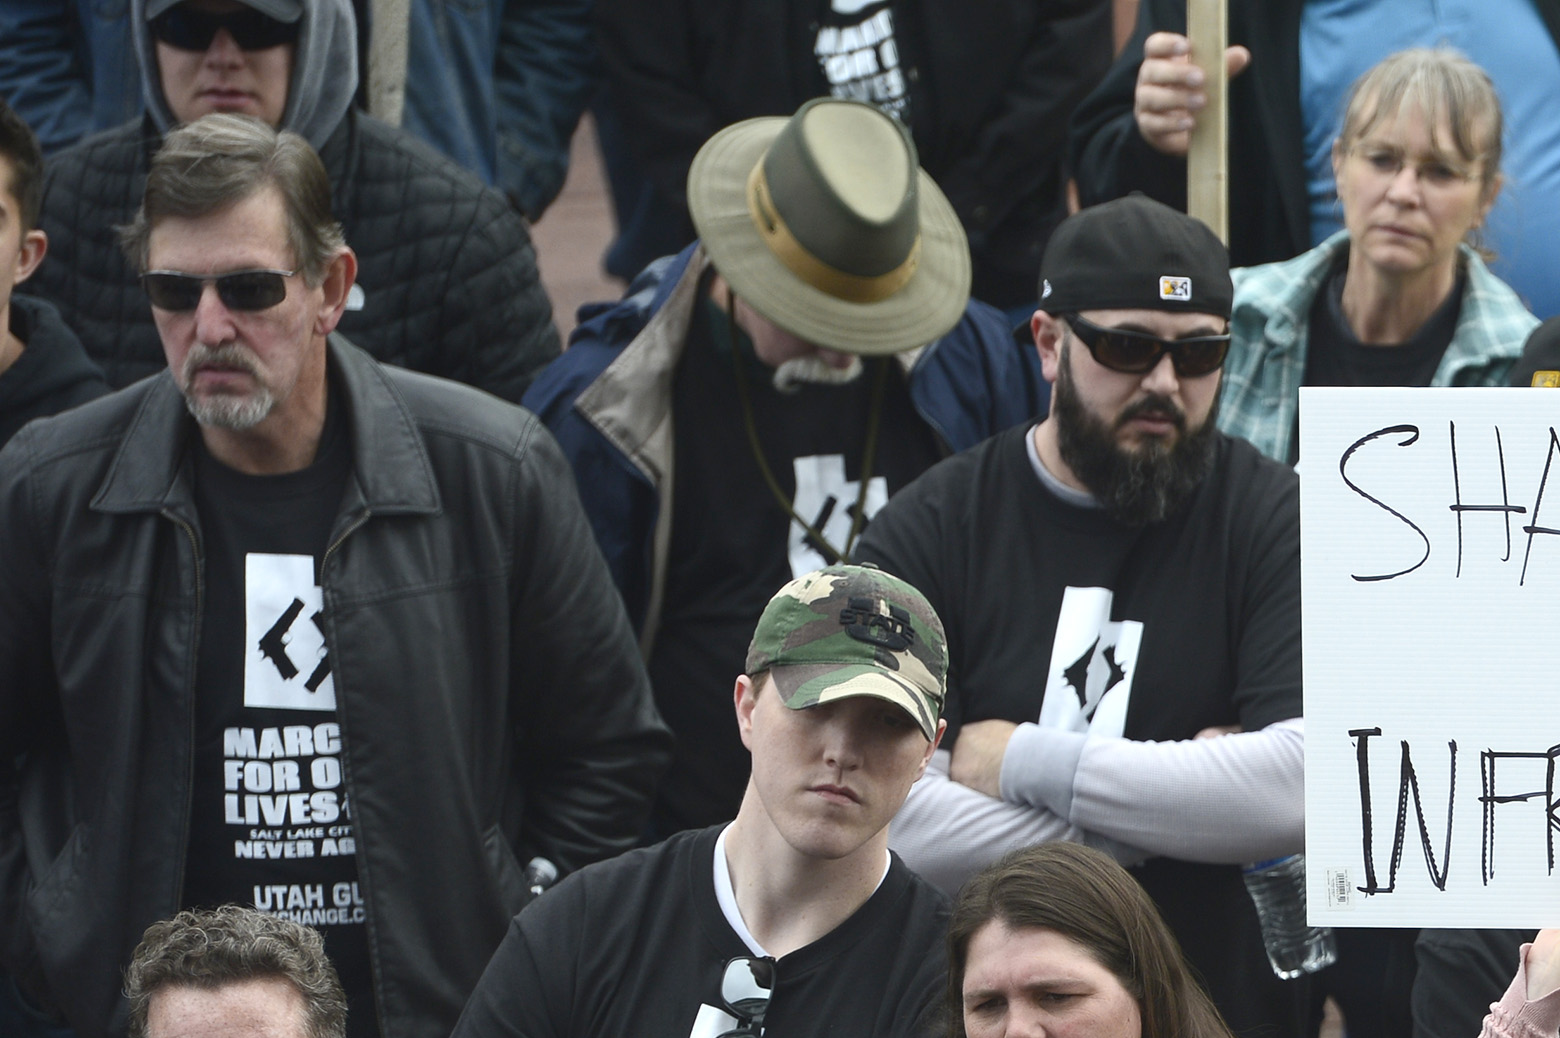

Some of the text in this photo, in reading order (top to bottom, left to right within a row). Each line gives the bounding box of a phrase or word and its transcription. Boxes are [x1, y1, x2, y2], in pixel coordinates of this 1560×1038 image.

[223, 722, 342, 759] MARC
[224, 756, 346, 793] FOR O
[224, 791, 340, 826] LIVES
[234, 837, 356, 859] NEVER AG
[250, 825, 353, 840] SALT LAKE CIT
[253, 883, 324, 911] UTAH
